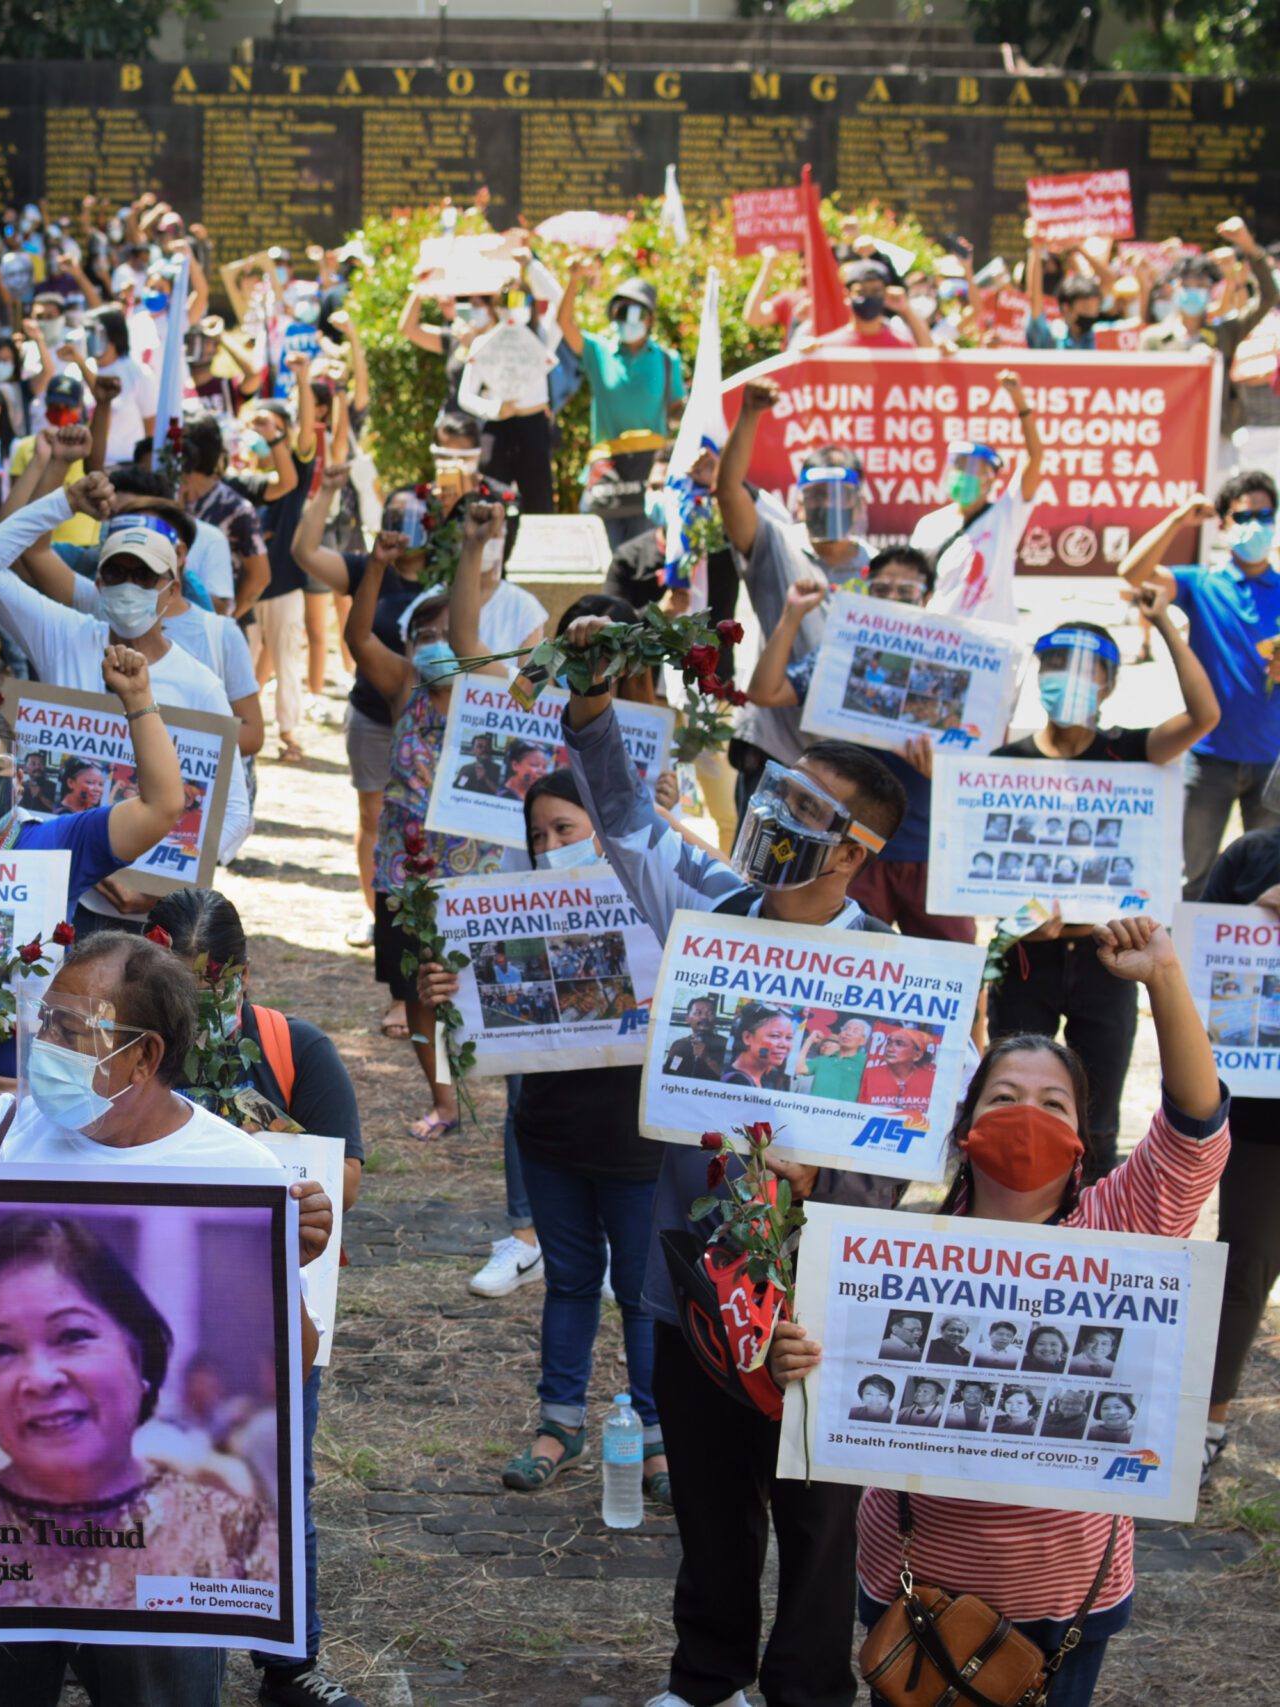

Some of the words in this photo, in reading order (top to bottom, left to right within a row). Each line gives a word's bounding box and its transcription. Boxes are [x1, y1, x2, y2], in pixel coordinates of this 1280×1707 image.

[121, 64, 530, 97] BANTAYOG
[603, 71, 681, 99] NG
[751, 73, 891, 101] MGA
[958, 77, 1237, 108] BAYANI
[884, 385, 958, 412] ANG
[884, 417, 934, 442] NG
[1112, 450, 1160, 477] SA
[846, 610, 961, 646] KABUHAYAN
[857, 629, 923, 655] BAYANI
[934, 646, 1001, 673] BAYAN!
[38, 730, 124, 758] BAYANI
[178, 758, 218, 779] AN!
[624, 740, 657, 760] AN!
[958, 772, 1112, 794] KATARUNGAN
[981, 792, 1061, 811] BAYANI
[1076, 797, 1154, 815] BAYAN!
[445, 887, 592, 917] KABUHAYAN
[595, 893, 622, 908] para
[442, 927, 467, 942] mga
[466, 914, 552, 938] BAYANI
[552, 919, 569, 933] ng
[568, 907, 648, 930] BAYAN
[682, 935, 904, 985] KATARUNGAN
[902, 974, 941, 991] para
[945, 980, 963, 993] sa
[1205, 953, 1234, 967] para
[1238, 956, 1251, 966] sa
[674, 969, 708, 987] mga
[708, 965, 825, 1002] BAYANI
[823, 991, 843, 1008] ng
[842, 984, 960, 1021] BAYAN!
[661, 1083, 689, 1094] rights
[691, 1087, 742, 1102] defenders
[744, 1095, 771, 1106] killed
[774, 1100, 810, 1114] during
[812, 1106, 866, 1121] pandemic
[843, 1236, 1109, 1284] KATARUNGAN
[1110, 1272, 1154, 1291] para
[1160, 1275, 1180, 1291] sa
[838, 1281, 880, 1302] mga
[880, 1273, 1018, 1311] BAYANI
[1019, 1298, 1043, 1317] ng
[1043, 1288, 1179, 1325] BAYAN!
[828, 1433, 843, 1443] 38
[846, 1434, 885, 1448] health
[888, 1440, 954, 1454] frontliners
[957, 1445, 987, 1457] have
[990, 1448, 1018, 1459] died
[1021, 1450, 1035, 1460] of
[1037, 1452, 1099, 1465] COVID-19
[29, 1518, 146, 1549] Tudtud
[190, 1582, 228, 1593] Health
[230, 1583, 274, 1598] Alliance
[190, 1596, 206, 1606] for
[209, 1597, 273, 1613] Democracy
